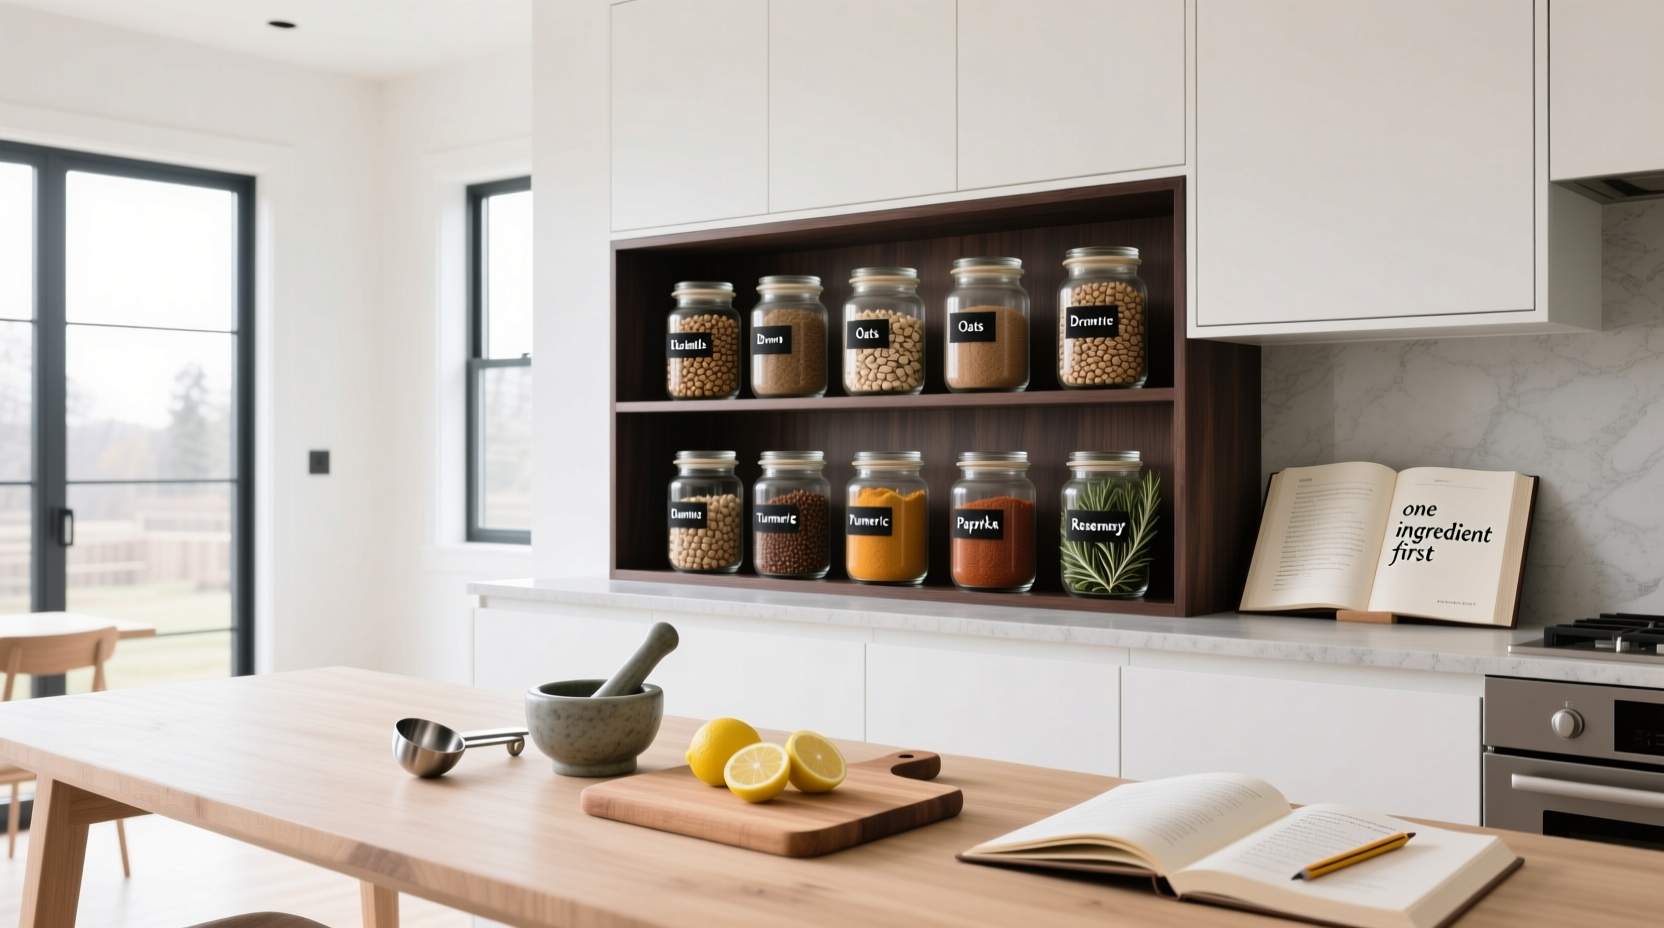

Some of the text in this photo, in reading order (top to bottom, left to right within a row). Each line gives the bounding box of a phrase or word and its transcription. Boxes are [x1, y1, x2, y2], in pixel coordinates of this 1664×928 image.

[957, 320, 984, 333] Oats
[856, 327, 880, 340] Oats
[1402, 504, 1438, 517] one
[1396, 521, 1493, 545] ingredient
[1388, 540, 1436, 567] first
